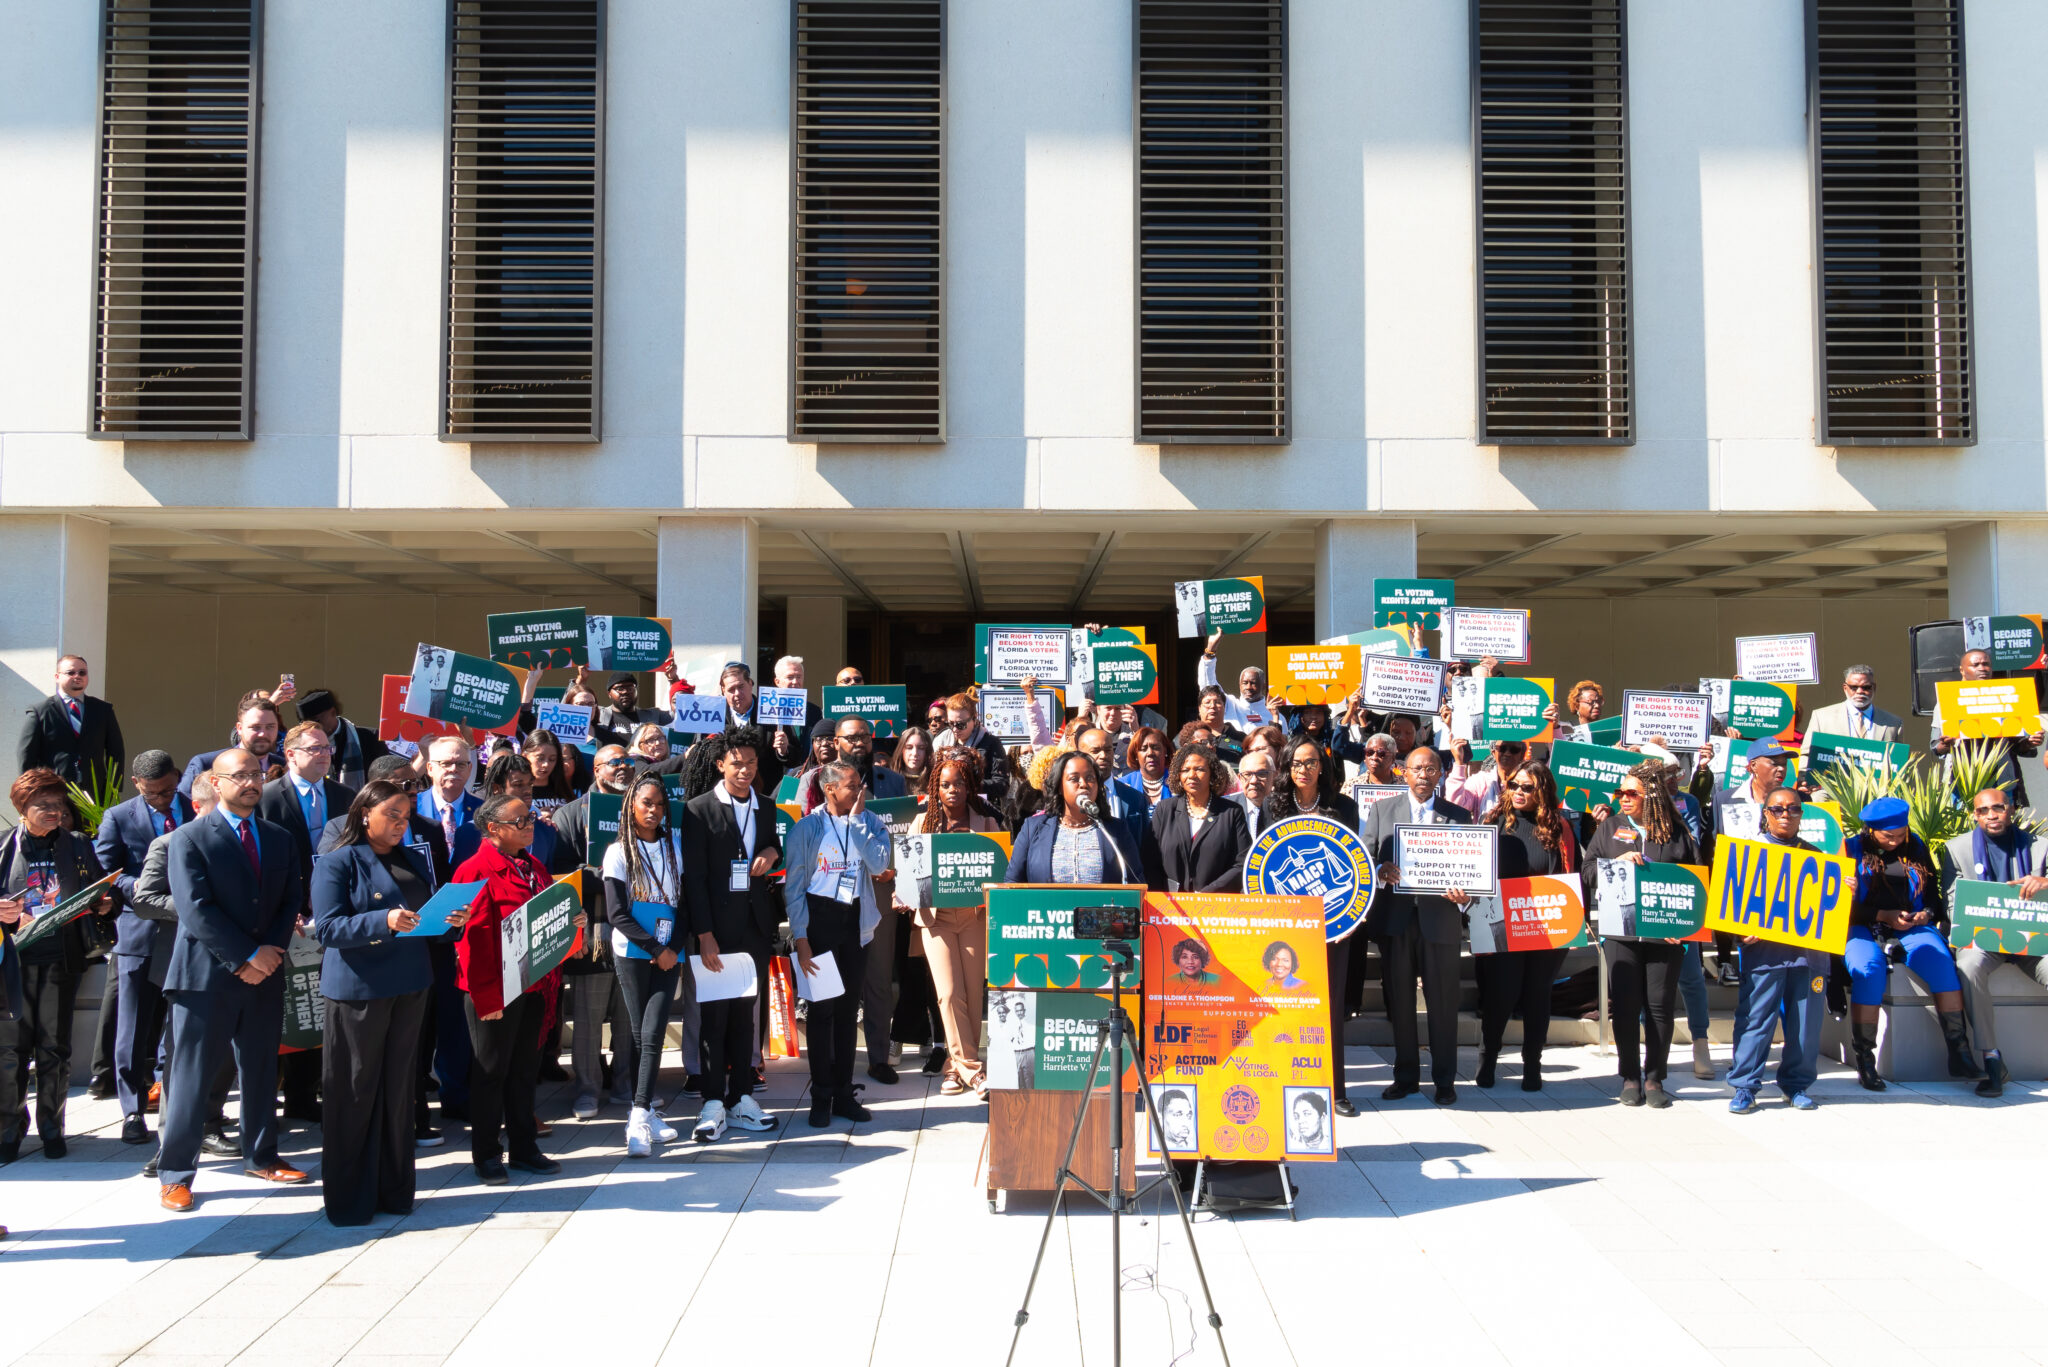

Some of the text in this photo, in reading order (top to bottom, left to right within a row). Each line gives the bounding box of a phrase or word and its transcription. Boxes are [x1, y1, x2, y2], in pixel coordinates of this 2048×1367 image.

[1209, 592, 1251, 603] BECAUSE
[1405, 589, 1433, 597] VOTING
[1210, 602, 1250, 613] OF THEM
[515, 622, 562, 633] FL VOTING
[499, 630, 579, 645] RIGHTS ACT NOW!
[617, 631, 660, 640] BECAUSE
[1994, 629, 2032, 639] BECAUSE
[617, 641, 658, 650] OF THEM
[1995, 638, 2031, 649] OF THEM
[1099, 660, 1144, 672] BECAUSE
[1099, 671, 1142, 682] OF THEM
[455, 672, 510, 694] BECAUSE
[1378, 685, 1411, 693] SUPPORT
[453, 684, 505, 705] OF THEM
[854, 696, 885, 704] VOTING
[1372, 691, 1403, 699] FLORIDA
[1489, 694, 1540, 705] BECAUSE
[1734, 695, 1782, 706] BECAUSE
[451, 697, 467, 708] Harry
[761, 695, 804, 707] PODER
[450, 703, 476, 714] Harriette
[483, 711, 502, 720] Moore
[760, 706, 804, 718] LATINX
[831, 704, 899, 713] RIGHTS ACT NOW!
[1489, 706, 1536, 717] OF THEM
[1733, 706, 1779, 717] OF THEM
[540, 713, 588, 726] PODER
[678, 709, 722, 722] VOTA
[540, 721, 586, 736] LATINX
[1579, 758, 1632, 773] FL VOTING
[1559, 765, 1618, 783] RIGHTS ACT
[938, 852, 995, 866] BECAUSE
[938, 865, 992, 878] OF THEM
[1249, 820, 1371, 921] FOR THE ADVANCEMENT OF COLORED PEOPLE
[1288, 862, 1324, 891] NAACP
[1640, 881, 1695, 896] BECAUSE
[1719, 842, 1842, 940] NAACP
[1509, 894, 1567, 909] GRACIAS
[1641, 895, 1693, 910] OF THEM
[1987, 896, 2001, 907] FL
[532, 897, 570, 935] BECAUSE
[1028, 910, 1043, 923] FL
[1511, 908, 1562, 922] A ELLOS
[1965, 905, 2034, 921] RIGHTS ACT
[1149, 916, 1320, 928] FLORIDA VOTING RIGHTS ACT
[1642, 916, 1667, 924] Harriette
[1676, 918, 1694, 926] Moore
[532, 913, 568, 949] OF THEM
[1002, 926, 1075, 939] RIGHTS AC
[293, 973, 312, 1030] OF THEM
[308, 971, 325, 1031] BECAUSE
[1044, 1019, 1099, 1035] BECAU
[1237, 1020, 1246, 1029] EG
[1154, 1025, 1192, 1043] LDF
[1232, 1030, 1252, 1039] EQUAL
[1300, 1035, 1325, 1044] RISING
[1043, 1036, 1064, 1051] OF
[1043, 1055, 1065, 1064] Harry
[1076, 1055, 1091, 1063] and
[1176, 1056, 1216, 1065] ACTION
[1292, 1057, 1322, 1068] ACLU
[1043, 1063, 1078, 1071] Harriette
[1176, 1066, 1203, 1075] FUND
[1292, 1071, 1307, 1080] FL
